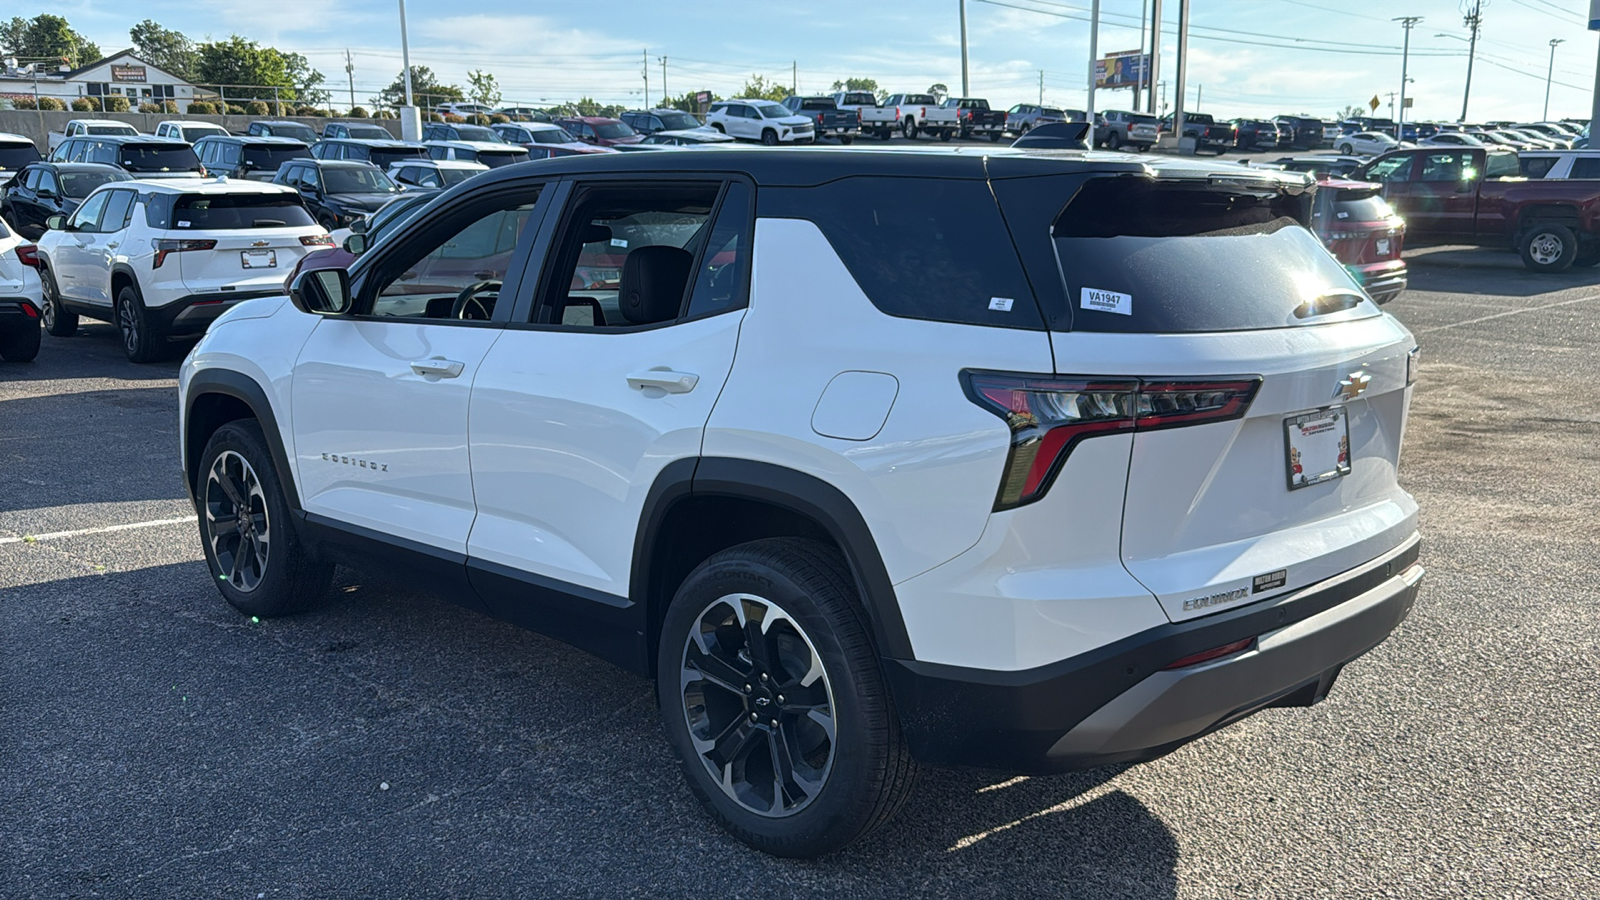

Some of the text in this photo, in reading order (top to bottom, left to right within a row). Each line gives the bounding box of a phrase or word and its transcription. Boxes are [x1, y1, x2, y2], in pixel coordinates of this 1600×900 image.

[1089, 291, 1121, 304] VA1947
[322, 452, 388, 472] EQUINOX
[1183, 586, 1249, 611] EQUINOX
